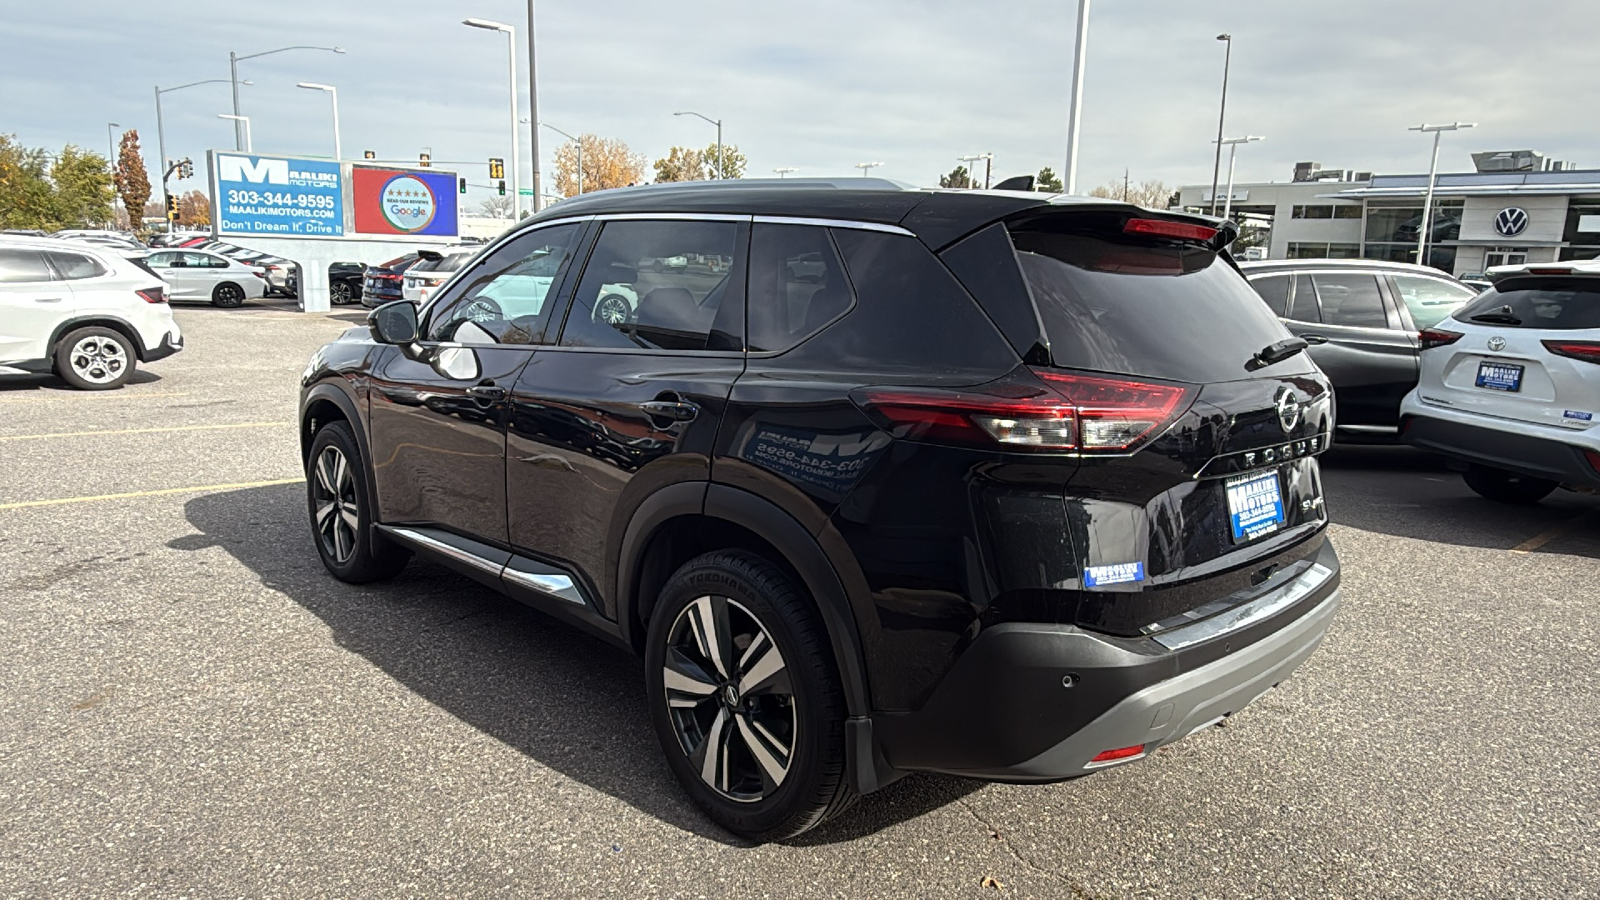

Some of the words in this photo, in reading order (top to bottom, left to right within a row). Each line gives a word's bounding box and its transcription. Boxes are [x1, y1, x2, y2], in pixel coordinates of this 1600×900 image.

[289, 179, 337, 189] MOTORS
[228, 189, 335, 209] 303-344-9595
[229, 205, 335, 219] MAALIKIMOTORS.COM
[391, 204, 426, 218] Google
[222, 219, 251, 230] Don't
[255, 221, 289, 232] Dream
[306, 224, 332, 233] Drive
[336, 225, 342, 233] It
[1244, 438, 1318, 468] ROGUE
